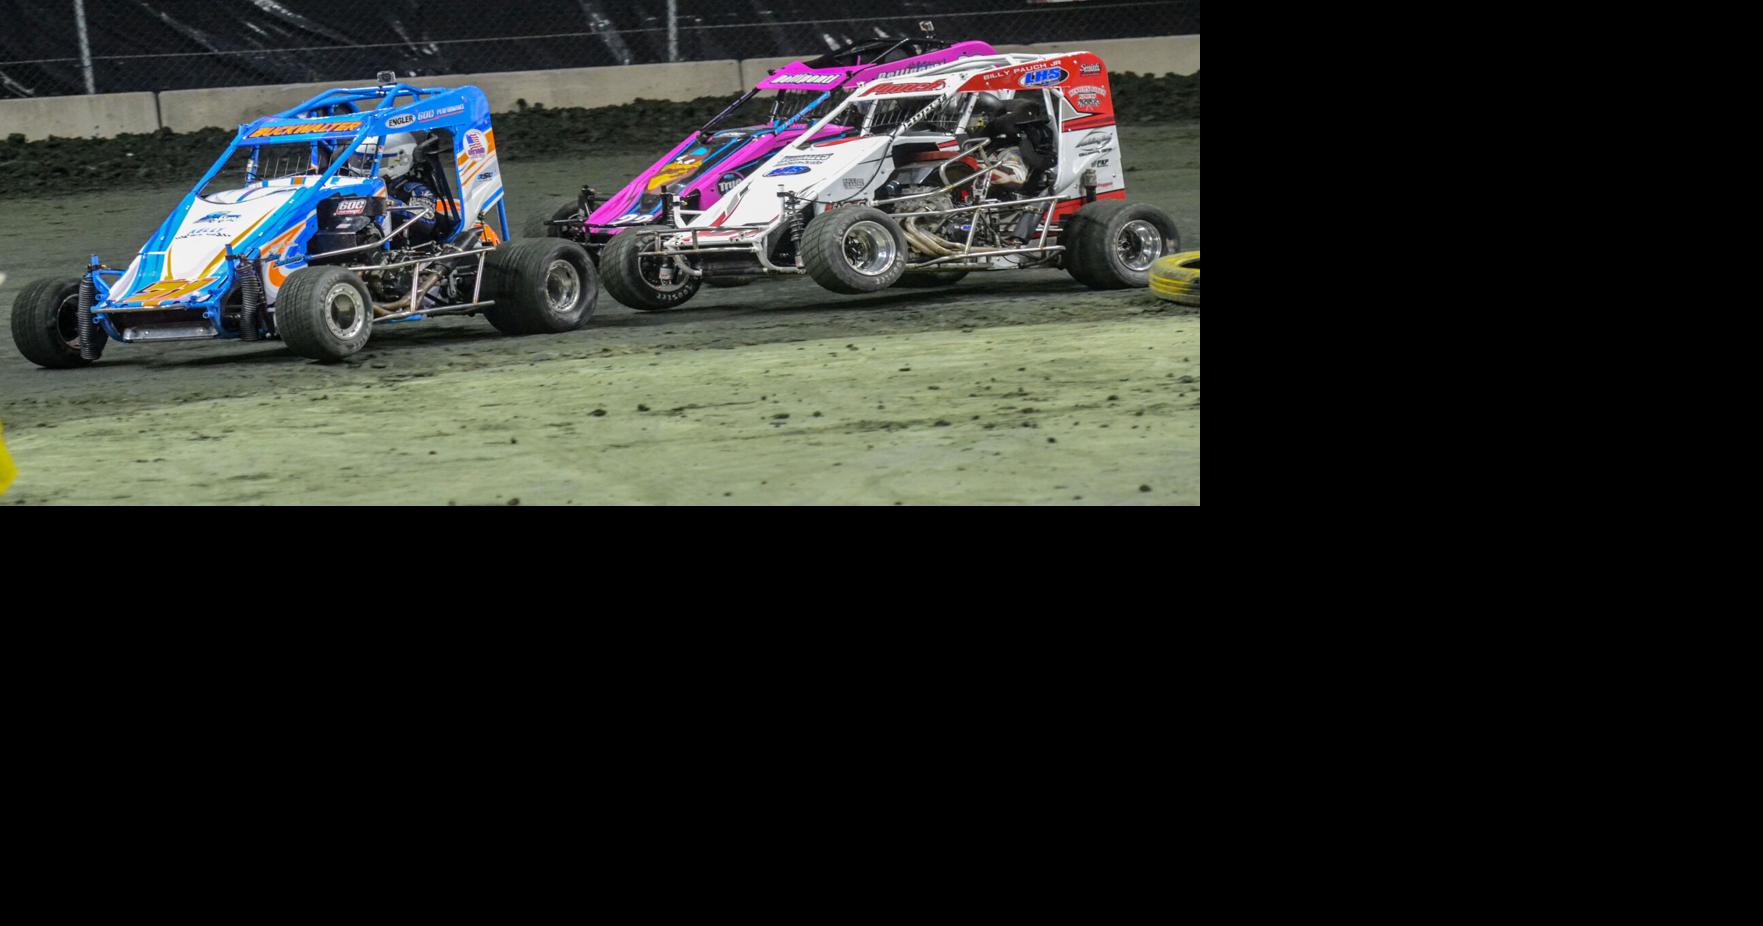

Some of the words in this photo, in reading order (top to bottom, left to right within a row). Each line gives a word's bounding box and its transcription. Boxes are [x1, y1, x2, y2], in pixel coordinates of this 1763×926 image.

[984, 70, 1010, 80] BILLY
[1014, 63, 1047, 74] PAUCH
[1025, 67, 1061, 84] LHS
[388, 114, 414, 127] ENGLER
[247, 121, 364, 138] BUCKWALTER
